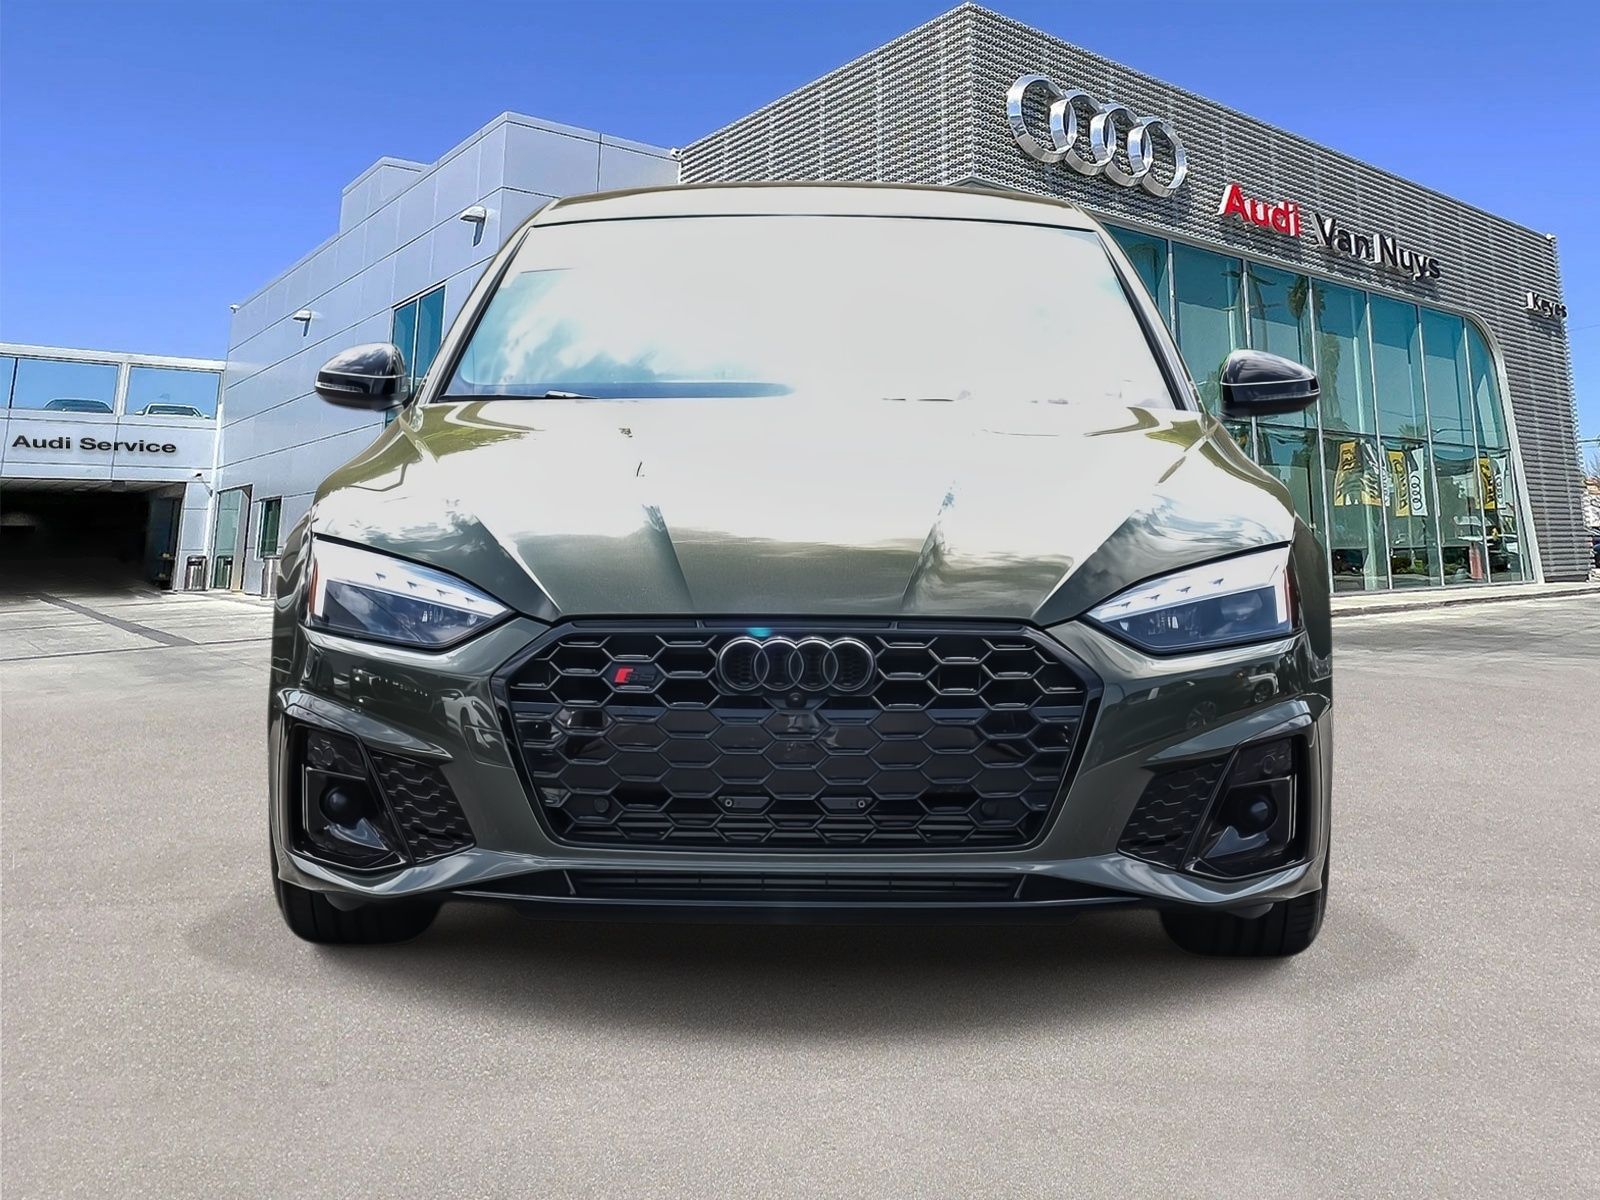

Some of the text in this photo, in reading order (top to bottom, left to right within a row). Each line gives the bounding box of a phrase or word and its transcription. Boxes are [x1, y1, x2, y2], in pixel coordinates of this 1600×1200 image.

[1218, 183, 1441, 280] Audi Van Nuys
[12, 435, 177, 453] Audi Service
